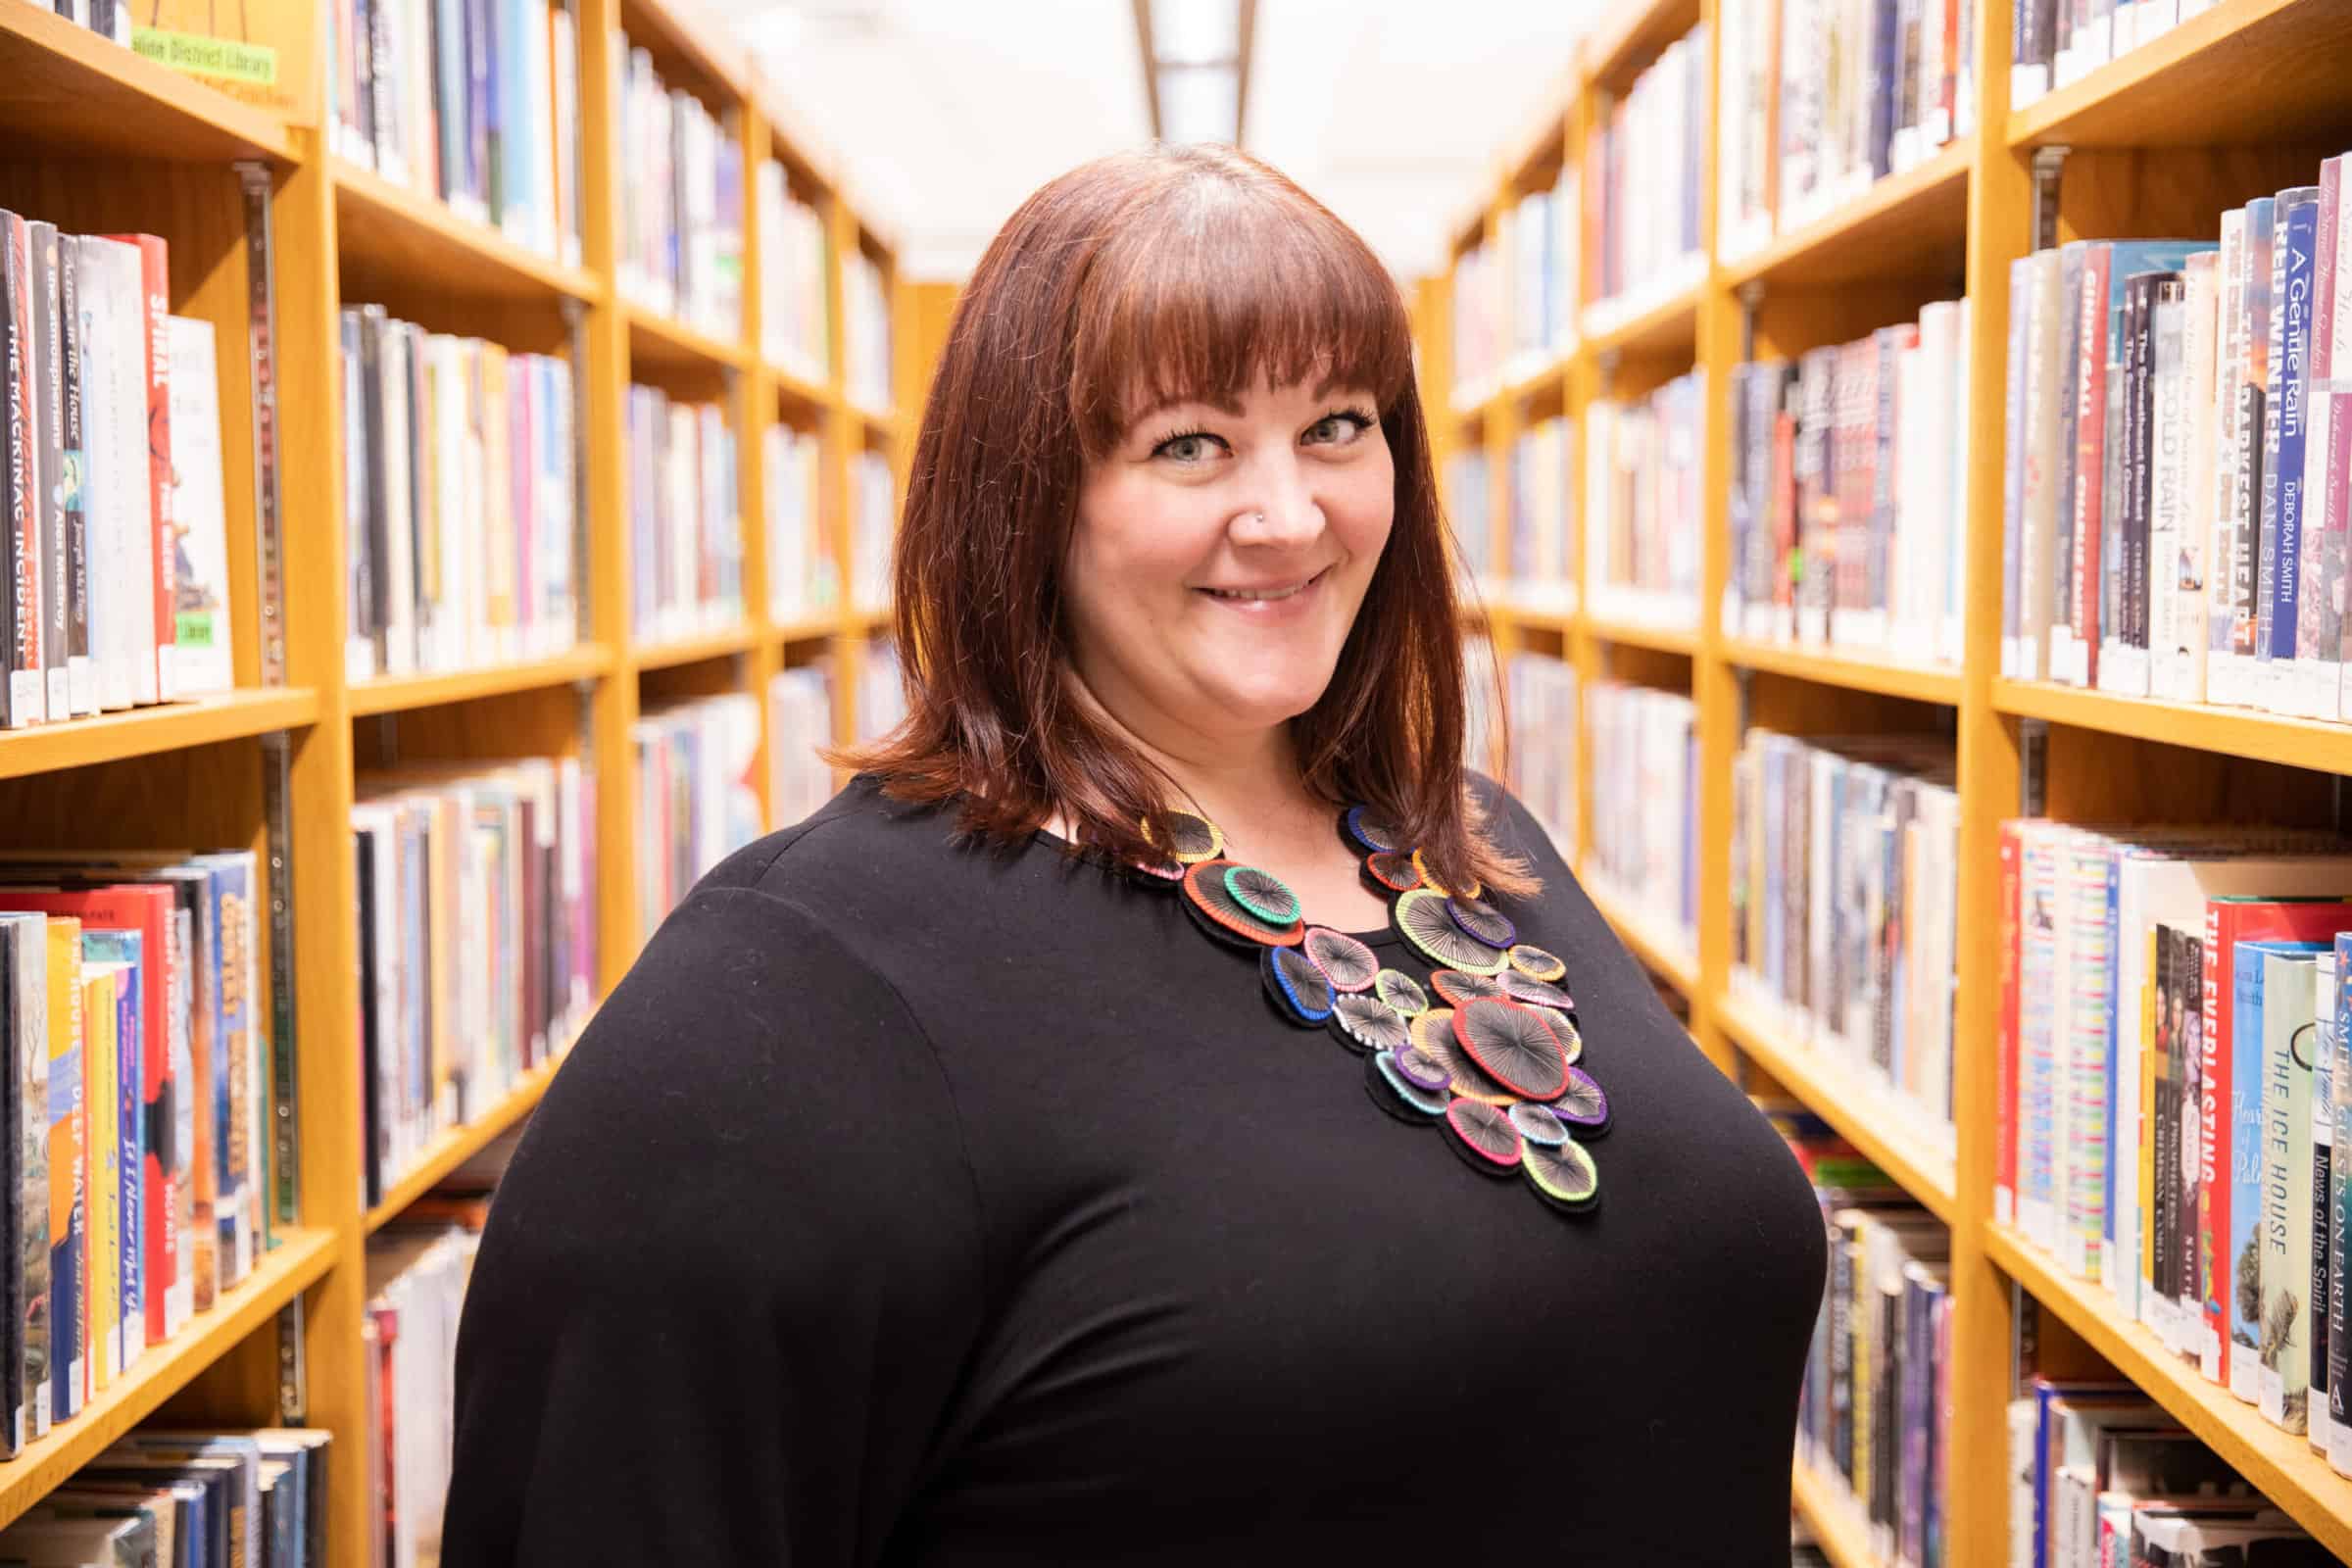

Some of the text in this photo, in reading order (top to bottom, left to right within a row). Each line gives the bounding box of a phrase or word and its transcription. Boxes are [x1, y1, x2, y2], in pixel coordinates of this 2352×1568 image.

[172, 39, 222, 68] District
[68, 346, 79, 380] the
[2081, 269, 2096, 419] GINNY GALL
[2265, 221, 2288, 455] RED WINTER
[2284, 248, 2306, 437] A Gentle Rain
[69, 383, 80, 440] House
[2158, 375, 2179, 533] COLD RAIN
[2235, 386, 2252, 530] DARKEST
[9, 322, 26, 655] THE MACKINAC INCIDENT
[2258, 473, 2278, 632] DAN SMITH
[2280, 481, 2296, 604] DEBORAH SMITH
[2326, 471, 2339, 526] Smith
[2233, 542, 2251, 646] HEART
[71, 1086, 82, 1146] DEEP
[2201, 909, 2220, 1184] THE EVERLASTING
[2337, 1010, 2351, 1094] SMITH
[73, 1156, 84, 1236] WATER
[2270, 1050, 2289, 1255] THE ICE HOUSE
[2332, 1105, 2349, 1333] GUESTS ON EARTH
[2183, 1235, 2194, 1298] SMITH
[2312, 1154, 2329, 1313] News of the Spirit
